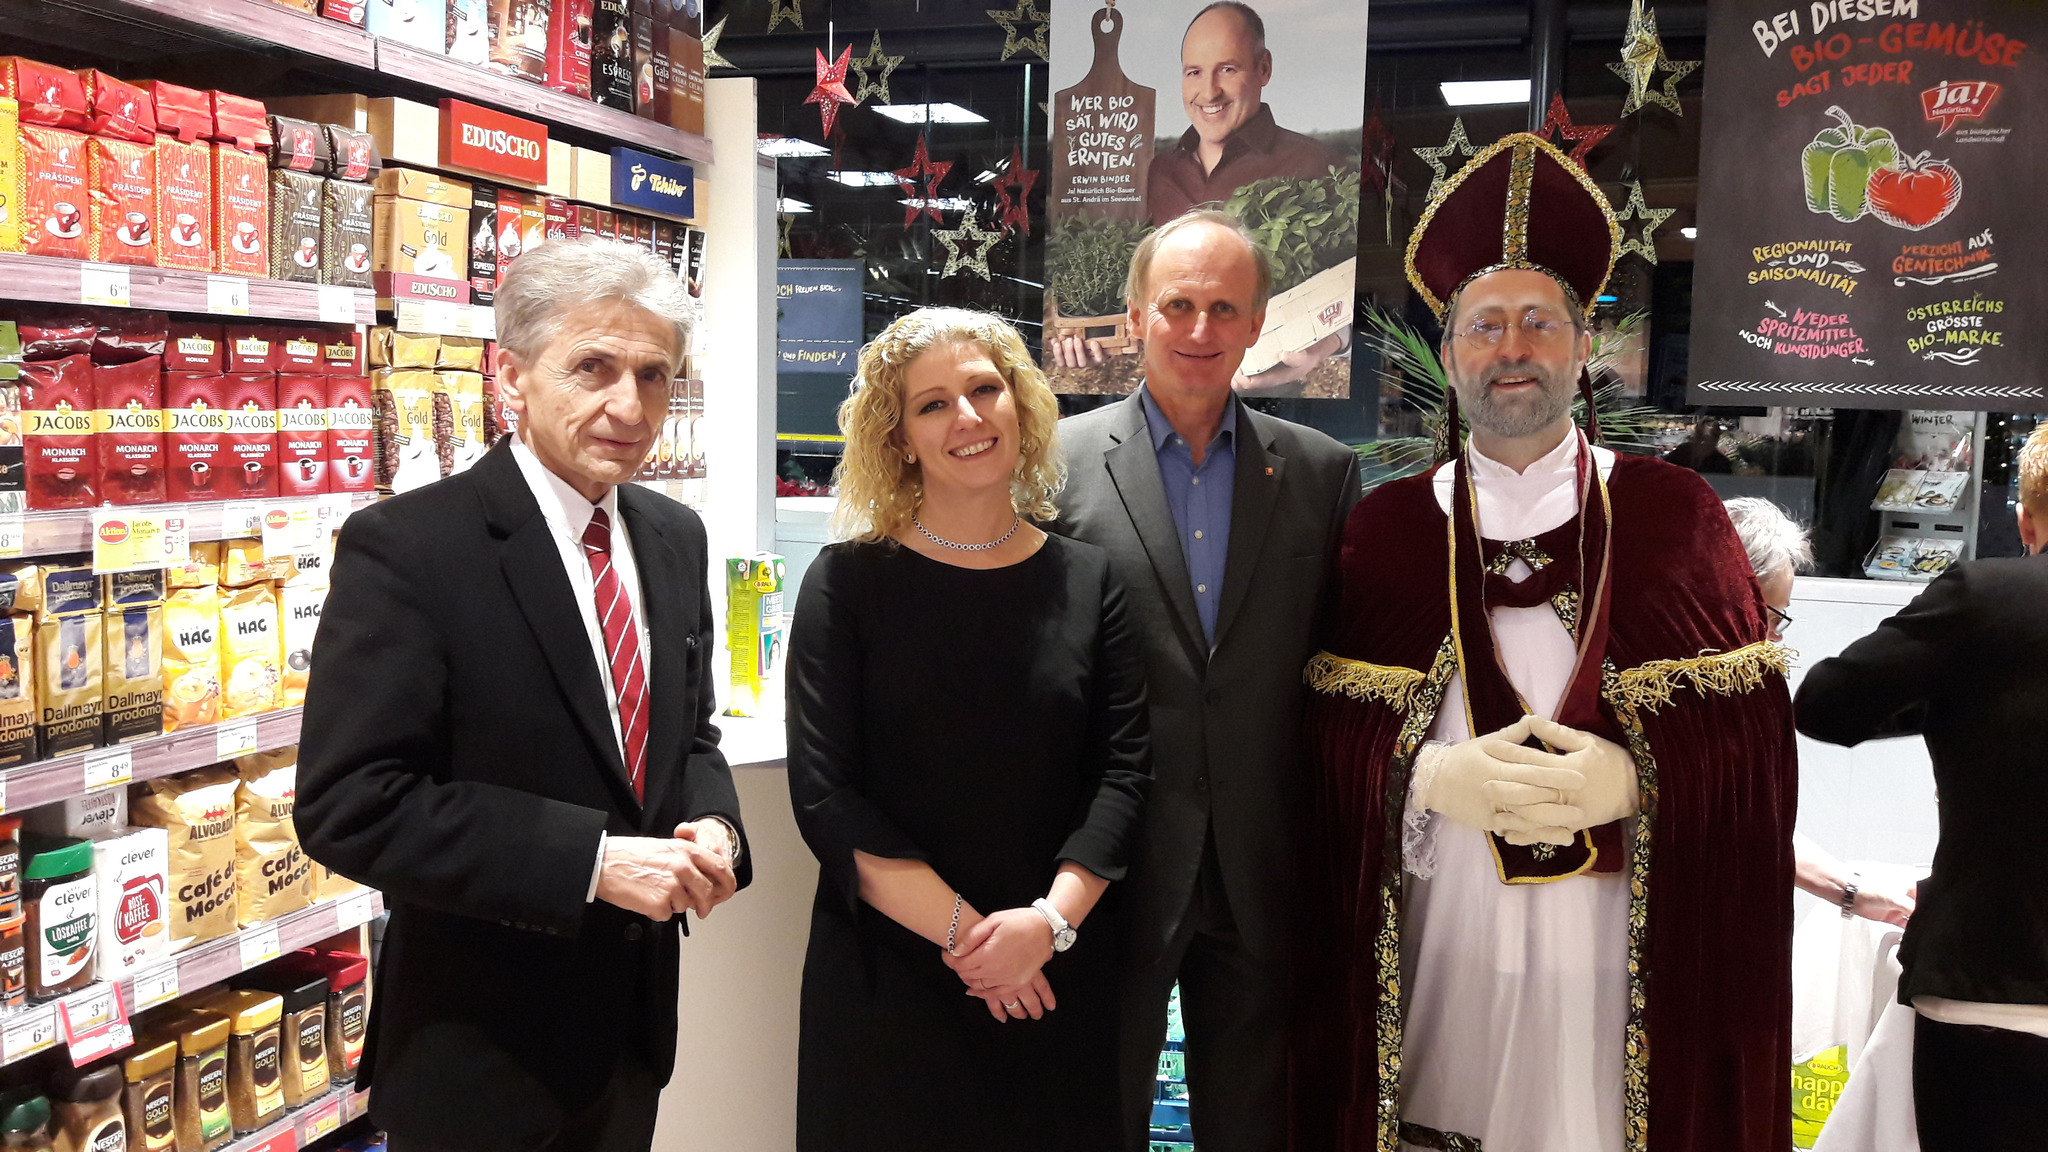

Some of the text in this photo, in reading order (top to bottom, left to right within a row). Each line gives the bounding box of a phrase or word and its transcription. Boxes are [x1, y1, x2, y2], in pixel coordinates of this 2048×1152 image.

[1752, 0, 1918, 58] BEI DIESEM
[1790, 20, 2028, 71] BIO-GEMÜSE
[1776, 60, 1914, 107] SAGT JEDER
[1934, 81, 1987, 108] ja!
[1071, 95, 1134, 113] WER BIO
[1932, 106, 1972, 116] Natürlich
[1066, 111, 1138, 132] SÄT, WIRD
[462, 123, 540, 161] EDUSCHO
[1079, 132, 1126, 151] GUTES
[1067, 147, 1135, 170] ERNTEN.
[649, 173, 688, 198] Tchibo
[1072, 174, 1130, 184] ERWIN BINDER
[423, 229, 448, 246] Gold
[1968, 228, 1994, 250] AUF
[1752, 240, 1852, 263] REGIONALITÄT
[1902, 241, 1962, 256] VERZICHT
[1788, 253, 1829, 268] UND
[411, 281, 457, 298] EDUSCHO
[1747, 267, 1858, 298] SAISONALITÄT.
[1907, 296, 2004, 321] ÖSTERREICHS
[1792, 307, 1850, 328] WEDER
[1927, 315, 1983, 333] GRÖSSTE
[1757, 317, 1857, 342] SPRITZMITTEL
[181, 340, 212, 352] JACOBS
[1738, 329, 1773, 350] NOCH
[1907, 330, 2004, 354] BIO-MARKE.
[327, 347, 354, 358] JACOBS
[32, 415, 91, 432] JACOBS
[105, 414, 160, 430] JACOBS
[171, 414, 224, 430] JACOBS
[226, 415, 276, 430] JACOBS
[282, 413, 326, 428] JACOBS
[332, 412, 372, 425] JACOBS
[407, 411, 428, 425] Gold
[461, 414, 481, 428] Gold
[41, 447, 86, 457] MONARCH
[115, 445, 158, 453] MONARCH
[178, 443, 219, 453] MONARCH
[233, 443, 271, 453] MONARCH
[288, 441, 322, 450] MONARCH
[336, 439, 369, 448] MONARCH
[298, 557, 321, 569] HAG
[52, 580, 94, 592] Dallmayr
[117, 572, 156, 584] Dallmayr
[238, 618, 267, 635] HAG
[180, 629, 212, 646] HAG
[109, 690, 161, 710] Dallmayr
[43, 701, 102, 723] Dallmayr
[112, 704, 161, 726] prodomo
[0, 726, 34, 743] domo
[47, 716, 100, 740] prodomo
[81, 808, 115, 825] clever
[270, 802, 293, 818] ALVO
[121, 848, 155, 866] clever
[261, 845, 299, 877] Café
[0, 862, 17, 872] ZERA
[178, 870, 222, 902] Café
[55, 887, 91, 906] clever
[124, 903, 151, 928] KAFFEE
[343, 1012, 361, 1025] GOLD
[301, 1031, 320, 1047] GOLD
[255, 1054, 275, 1070] GOLD
[200, 1077, 222, 1094] GOLD
[1791, 1070, 1847, 1099] happ
[145, 1104, 169, 1121] GOLD
